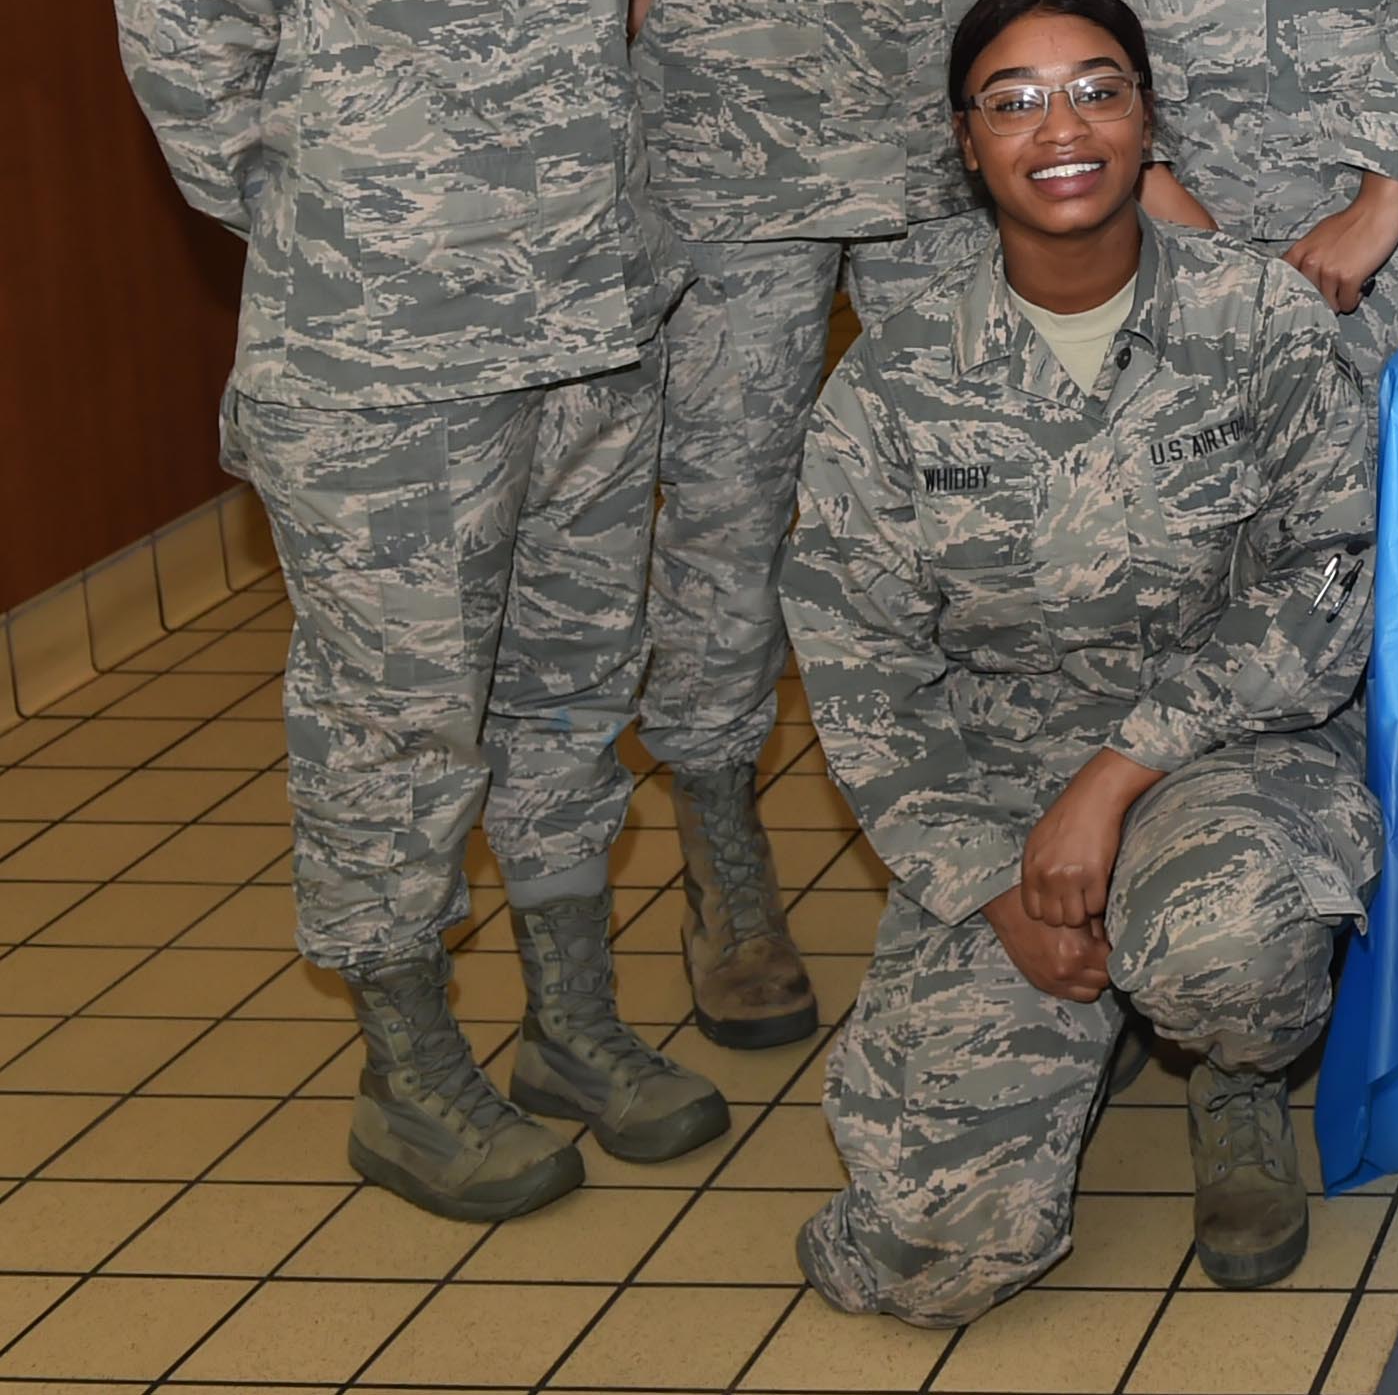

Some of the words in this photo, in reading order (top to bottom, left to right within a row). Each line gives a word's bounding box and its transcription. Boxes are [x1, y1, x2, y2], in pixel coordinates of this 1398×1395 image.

[1150, 439, 1189, 465] U.S.
[1192, 428, 1220, 457] AIR
[923, 465, 991, 492] WHIDBY
